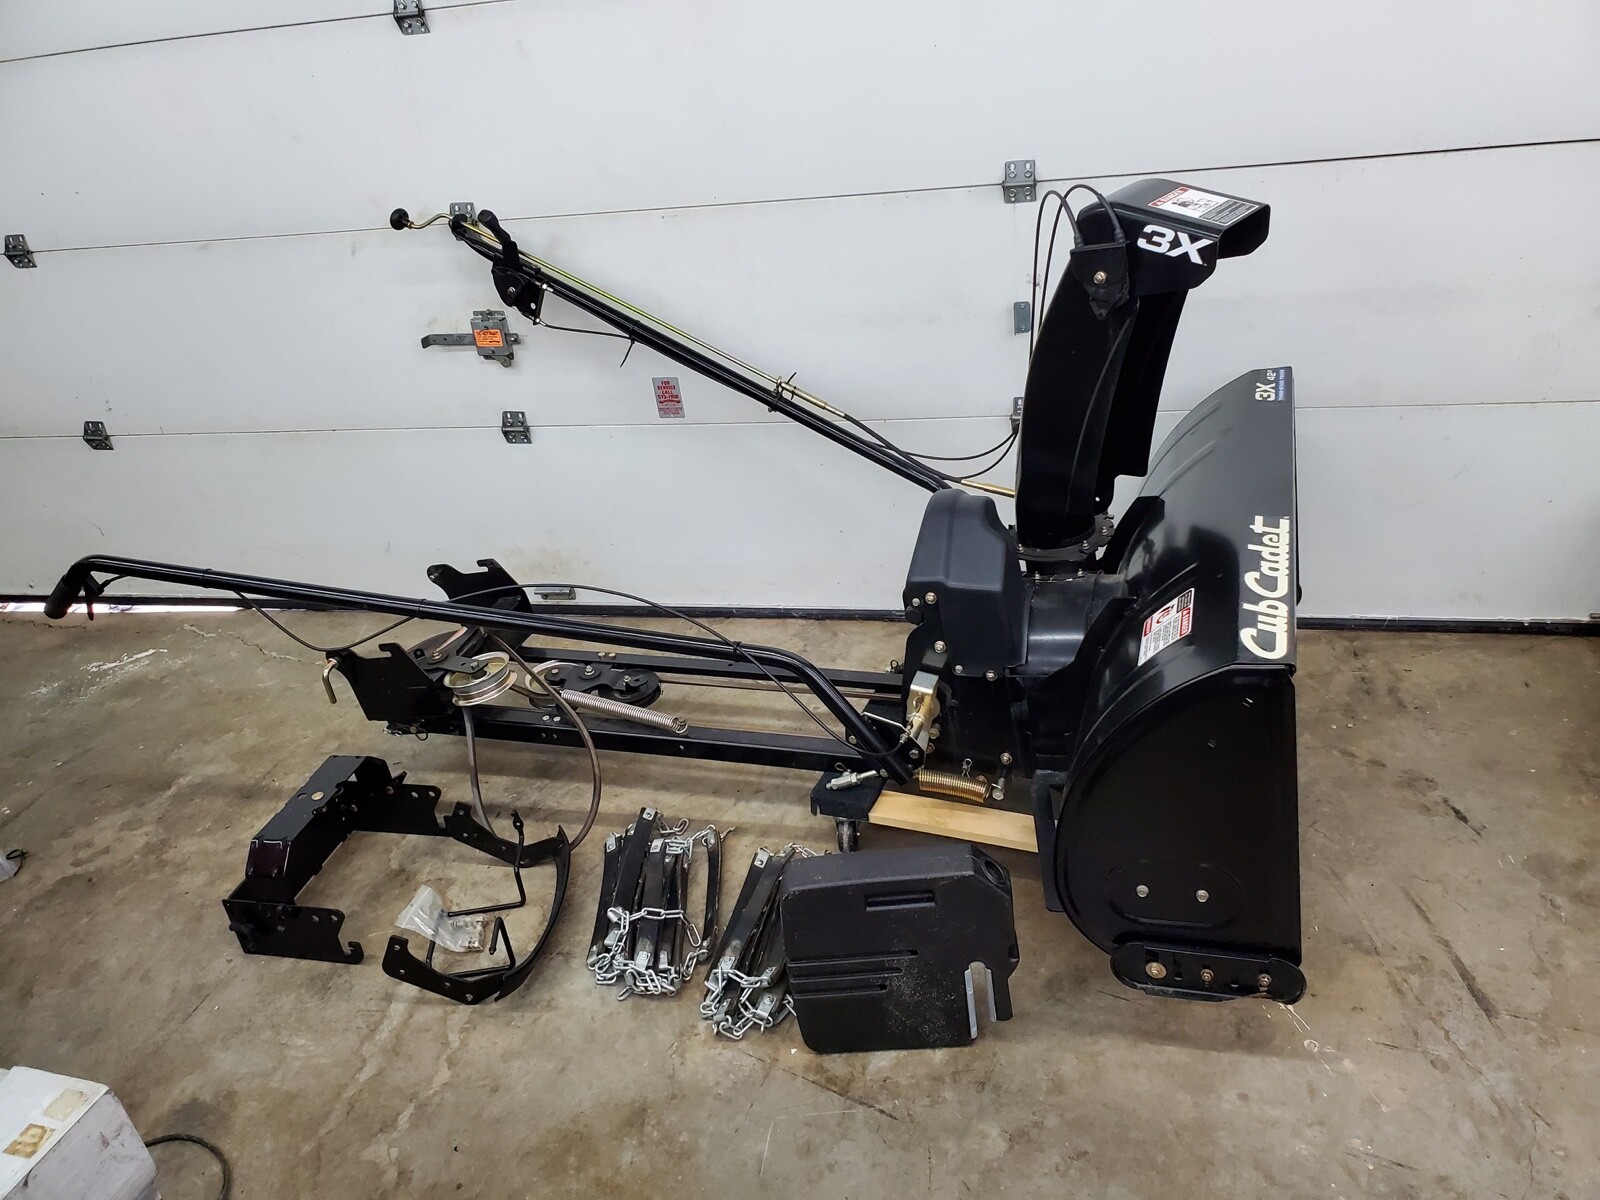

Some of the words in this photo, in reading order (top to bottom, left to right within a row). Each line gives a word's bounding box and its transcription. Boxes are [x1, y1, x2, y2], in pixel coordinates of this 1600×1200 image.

[1137, 224, 1214, 265] 3X
[1255, 382, 1276, 401] 3X
[1244, 515, 1290, 598] Cadet
[1240, 600, 1288, 659] Cub
